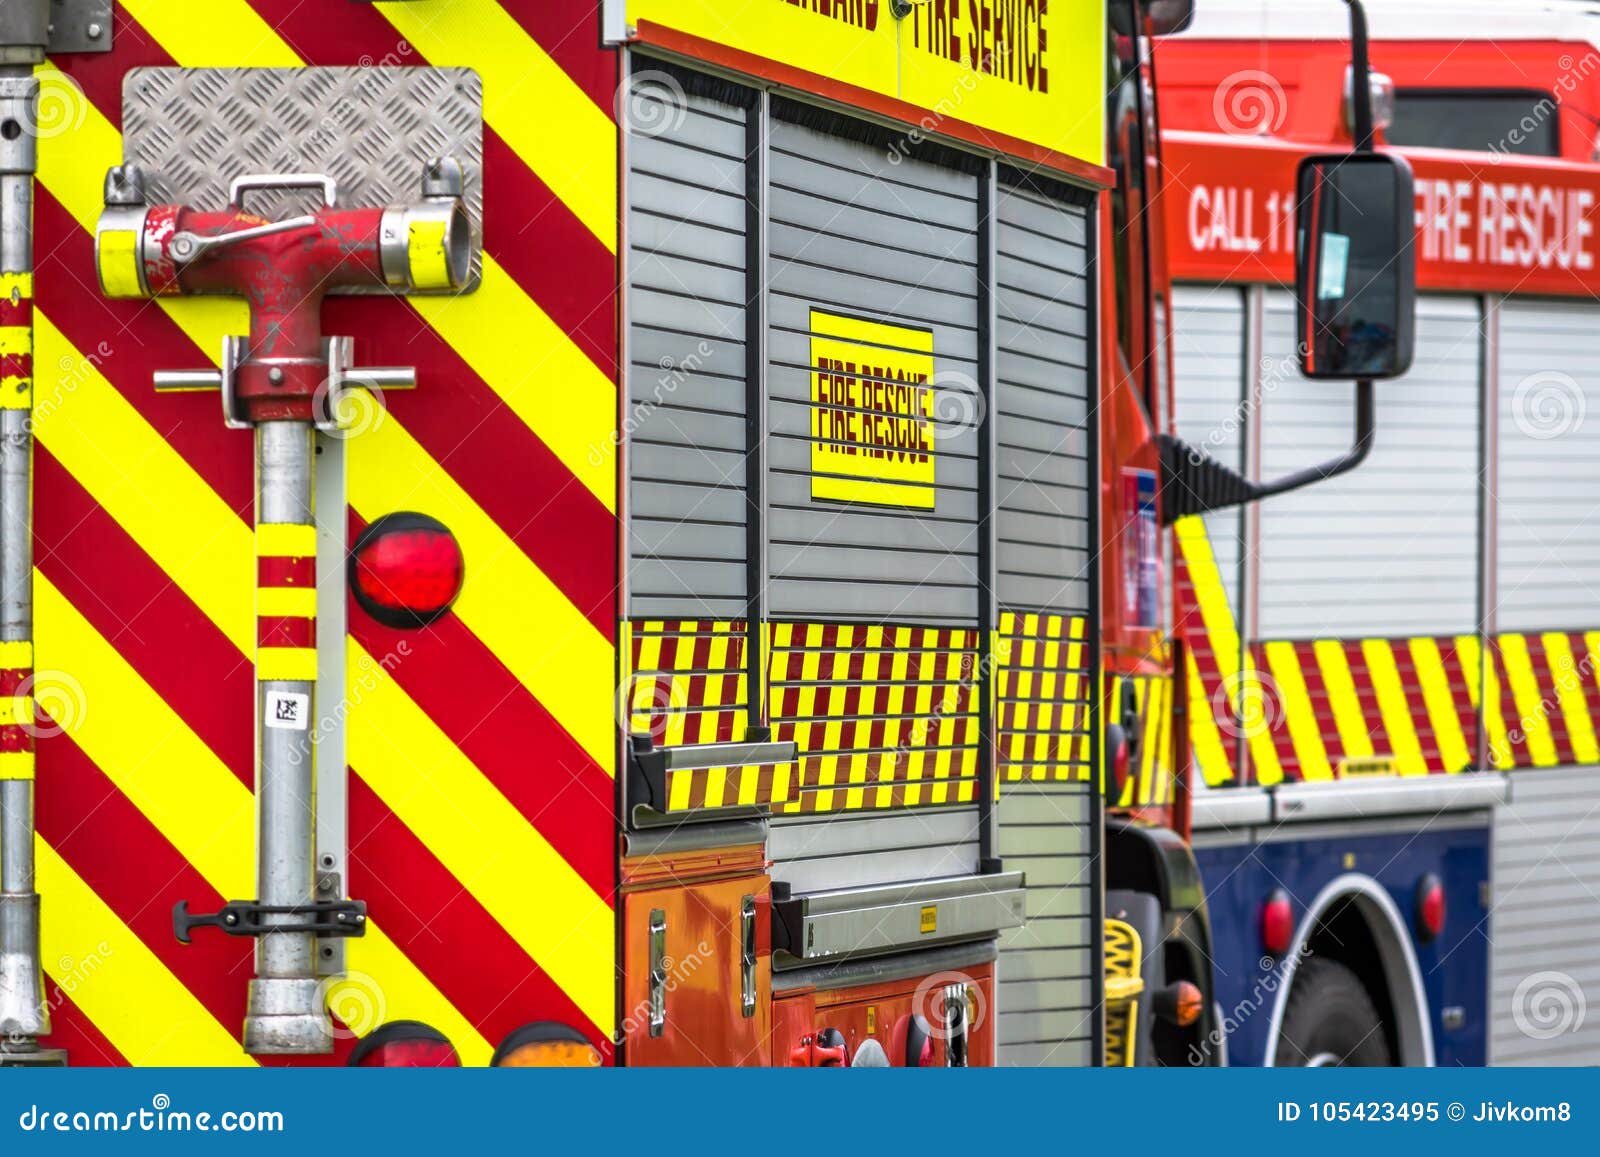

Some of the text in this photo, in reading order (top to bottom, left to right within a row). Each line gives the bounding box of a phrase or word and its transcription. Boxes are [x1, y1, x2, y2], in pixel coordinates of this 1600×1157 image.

[967, 0, 1048, 93] SERVICE
[1189, 185, 1261, 251] CALL
[1478, 182, 1593, 270] RESCUE
[817, 356, 928, 465] FIRE RESCUE
